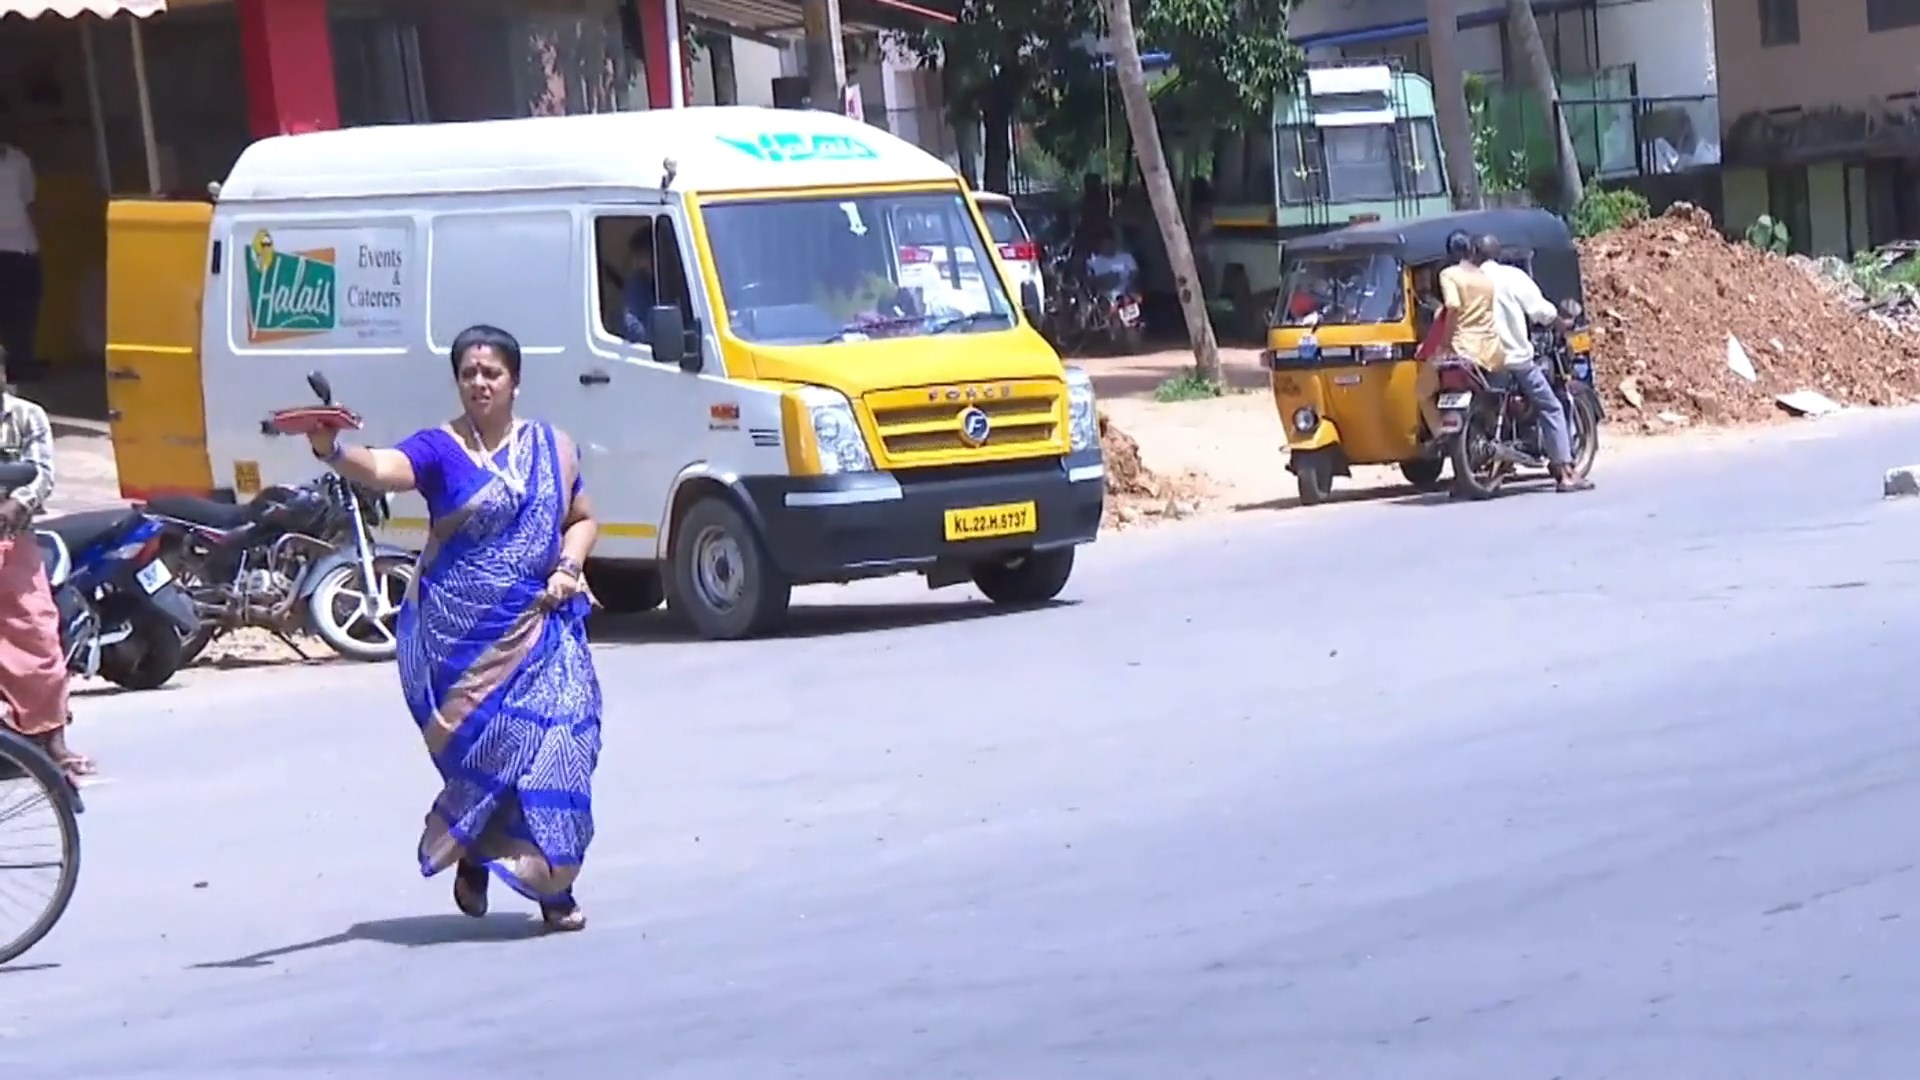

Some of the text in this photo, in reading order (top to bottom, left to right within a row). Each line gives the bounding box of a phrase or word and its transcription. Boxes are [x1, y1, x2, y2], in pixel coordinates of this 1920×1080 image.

[358, 245, 402, 268] Events
[392, 270, 401, 286] &
[251, 256, 331, 339] Halais
[347, 286, 401, 308] Caterers
